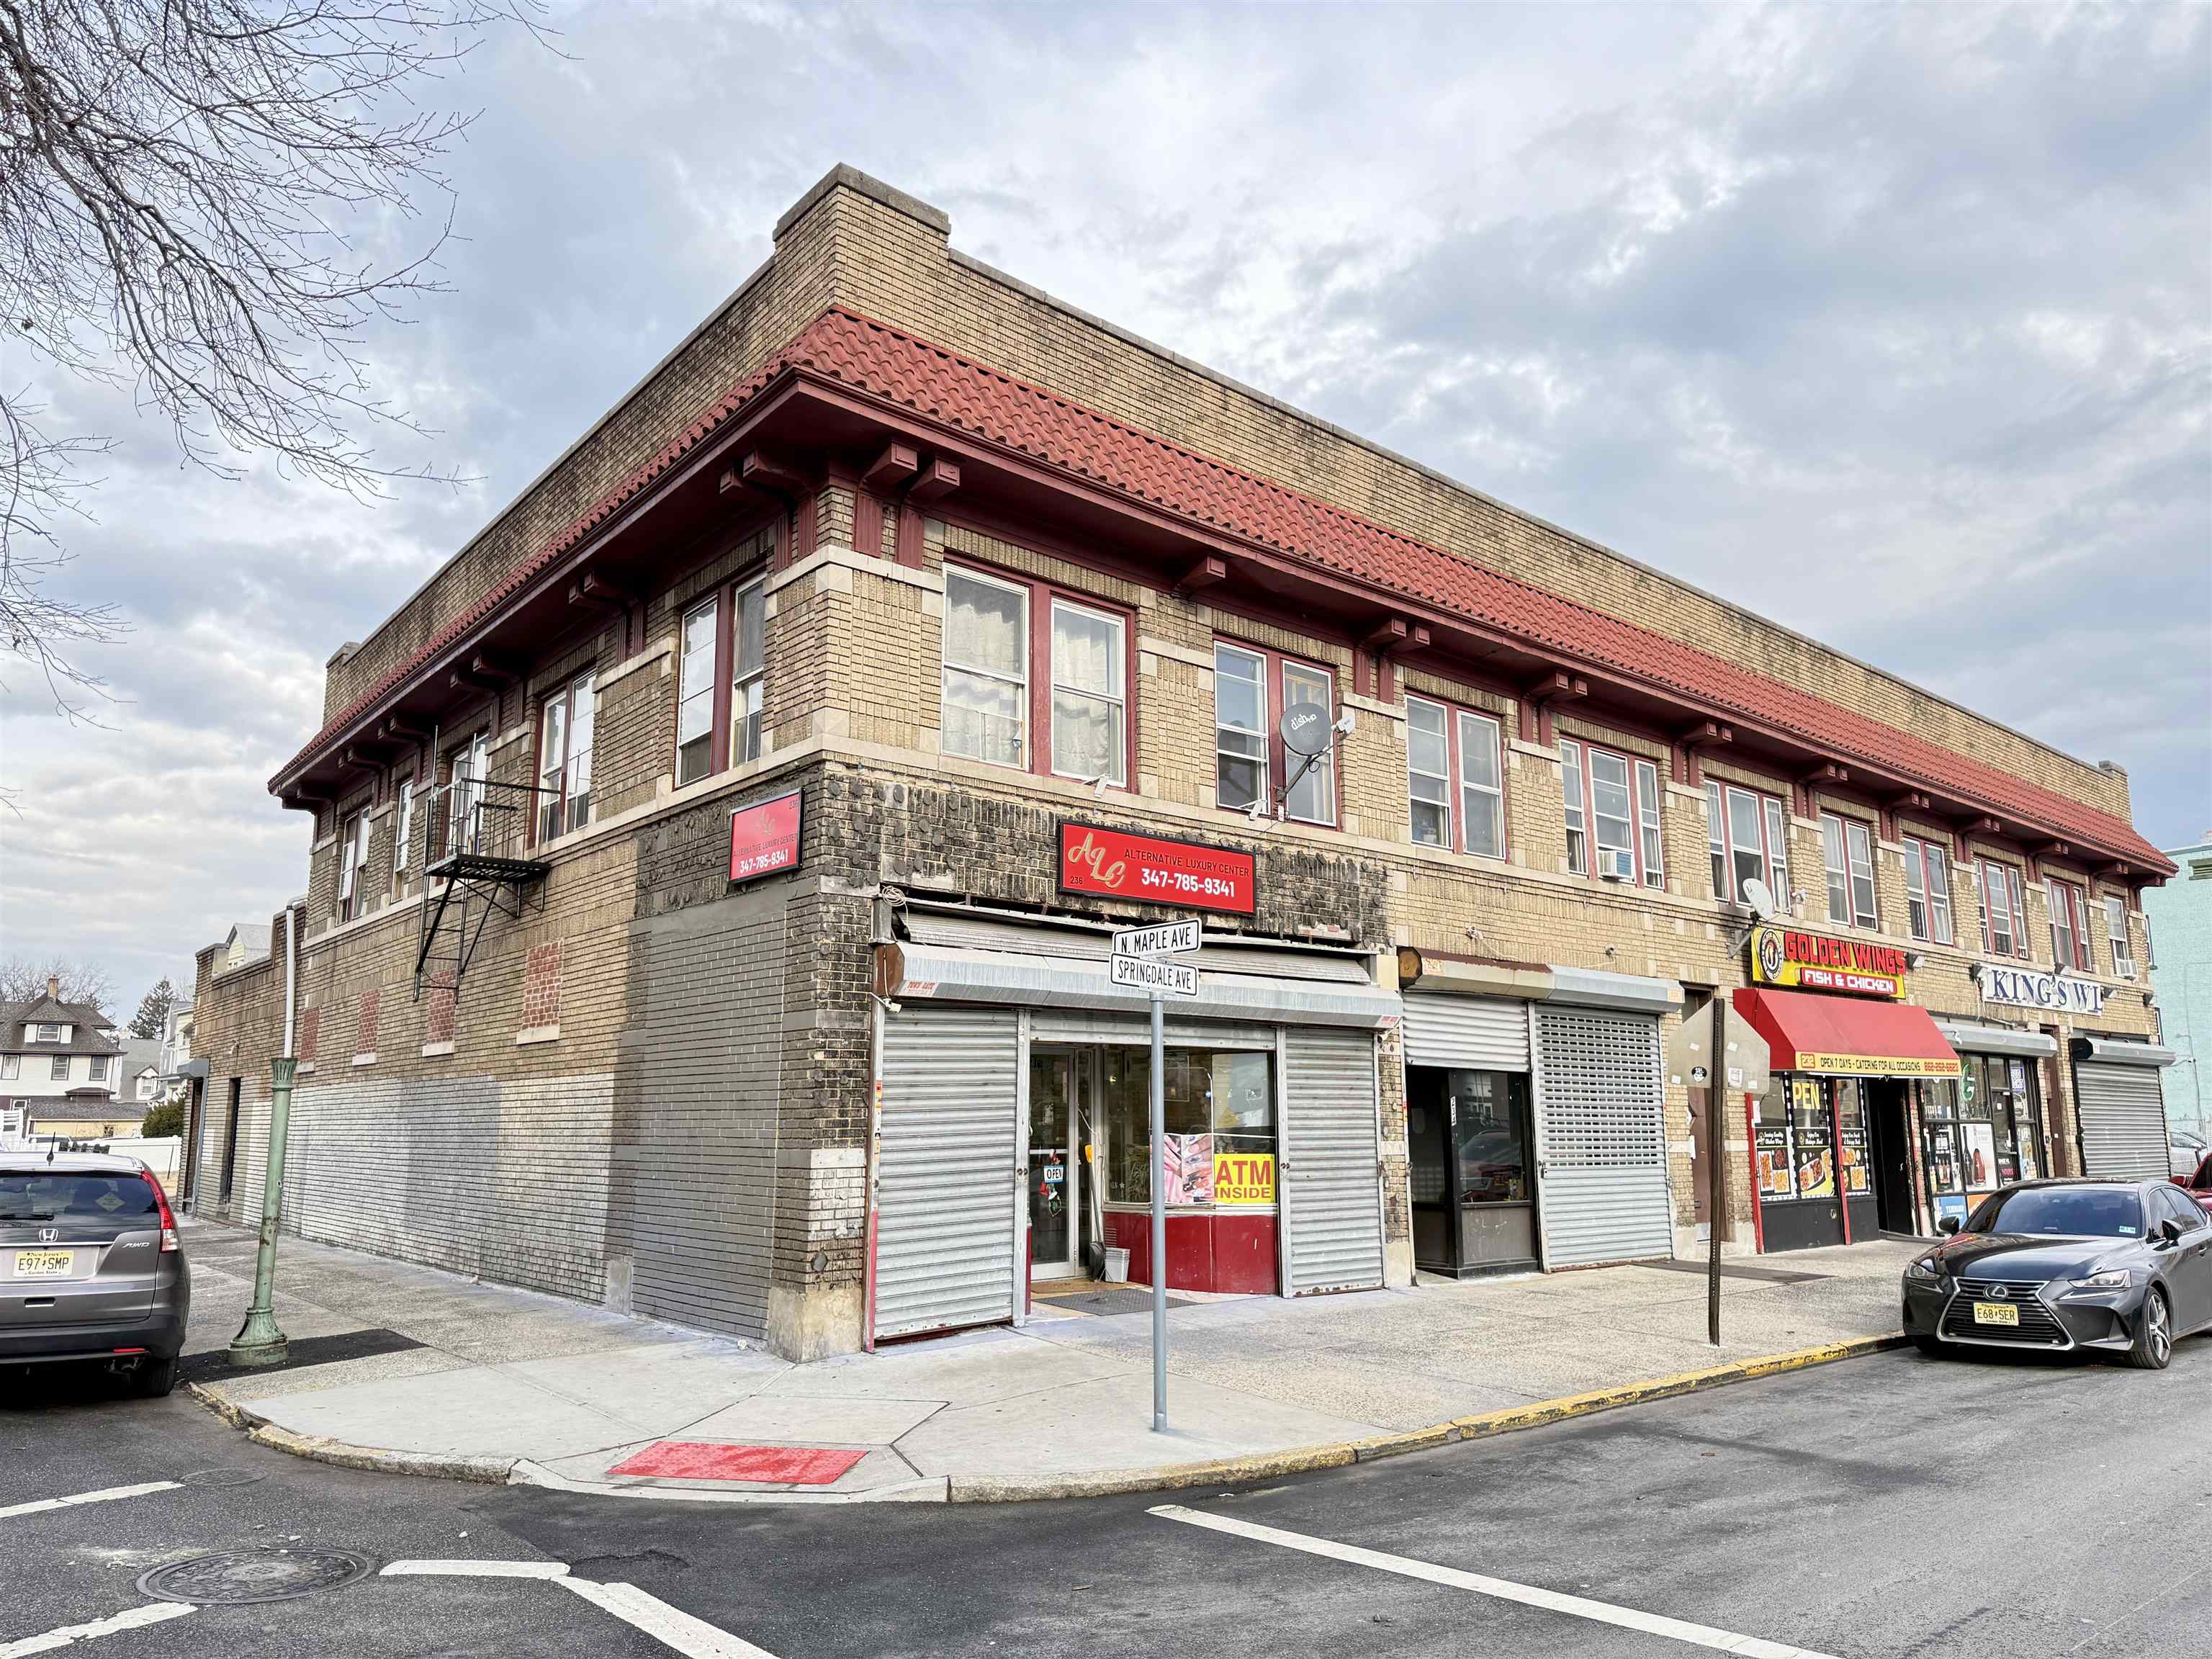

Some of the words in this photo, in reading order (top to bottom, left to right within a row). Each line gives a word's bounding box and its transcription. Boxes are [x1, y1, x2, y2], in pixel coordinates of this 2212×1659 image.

[1291, 714, 1308, 730] dish
[739, 849, 788, 873] 347-785-9341
[1124, 848, 1182, 866] ALTERNATIVE
[1186, 858, 1217, 872] LUXURY
[1219, 863, 1249, 876] CENTER
[1141, 868, 1236, 898] 347-785-9341
[1121, 936, 1130, 953] N.
[1134, 930, 1167, 953] MAPLE
[1172, 927, 1191, 947] AVE
[1784, 932, 1852, 967] GOLDEN
[1853, 943, 1906, 974] WINGS
[1118, 960, 1172, 986] SPRINGDALE
[1175, 970, 1191, 989] AVE
[1804, 970, 1832, 985] FISH
[1835, 975, 1844, 986] &
[1846, 976, 1894, 992] CHICKEN
[1992, 969, 2067, 1006] KING'S
[1820, 1057, 1833, 1068] OPEN
[1839, 1058, 1851, 1069] DAYS
[1856, 1059, 1877, 1070] CATERING
[1878, 1061, 1887, 1070] FOR
[1897, 1061, 1920, 1071] OCCASIONS
[1047, 1169, 1062, 1179] OPEN
[1215, 1160, 1271, 1185] ATM
[1214, 1187, 1271, 1198] INSIDE
[18, 1257, 40, 1271] E97
[48, 1257, 69, 1270] SMP
[1977, 1308, 1993, 1319] E68
[1998, 1309, 2015, 1321] SER
